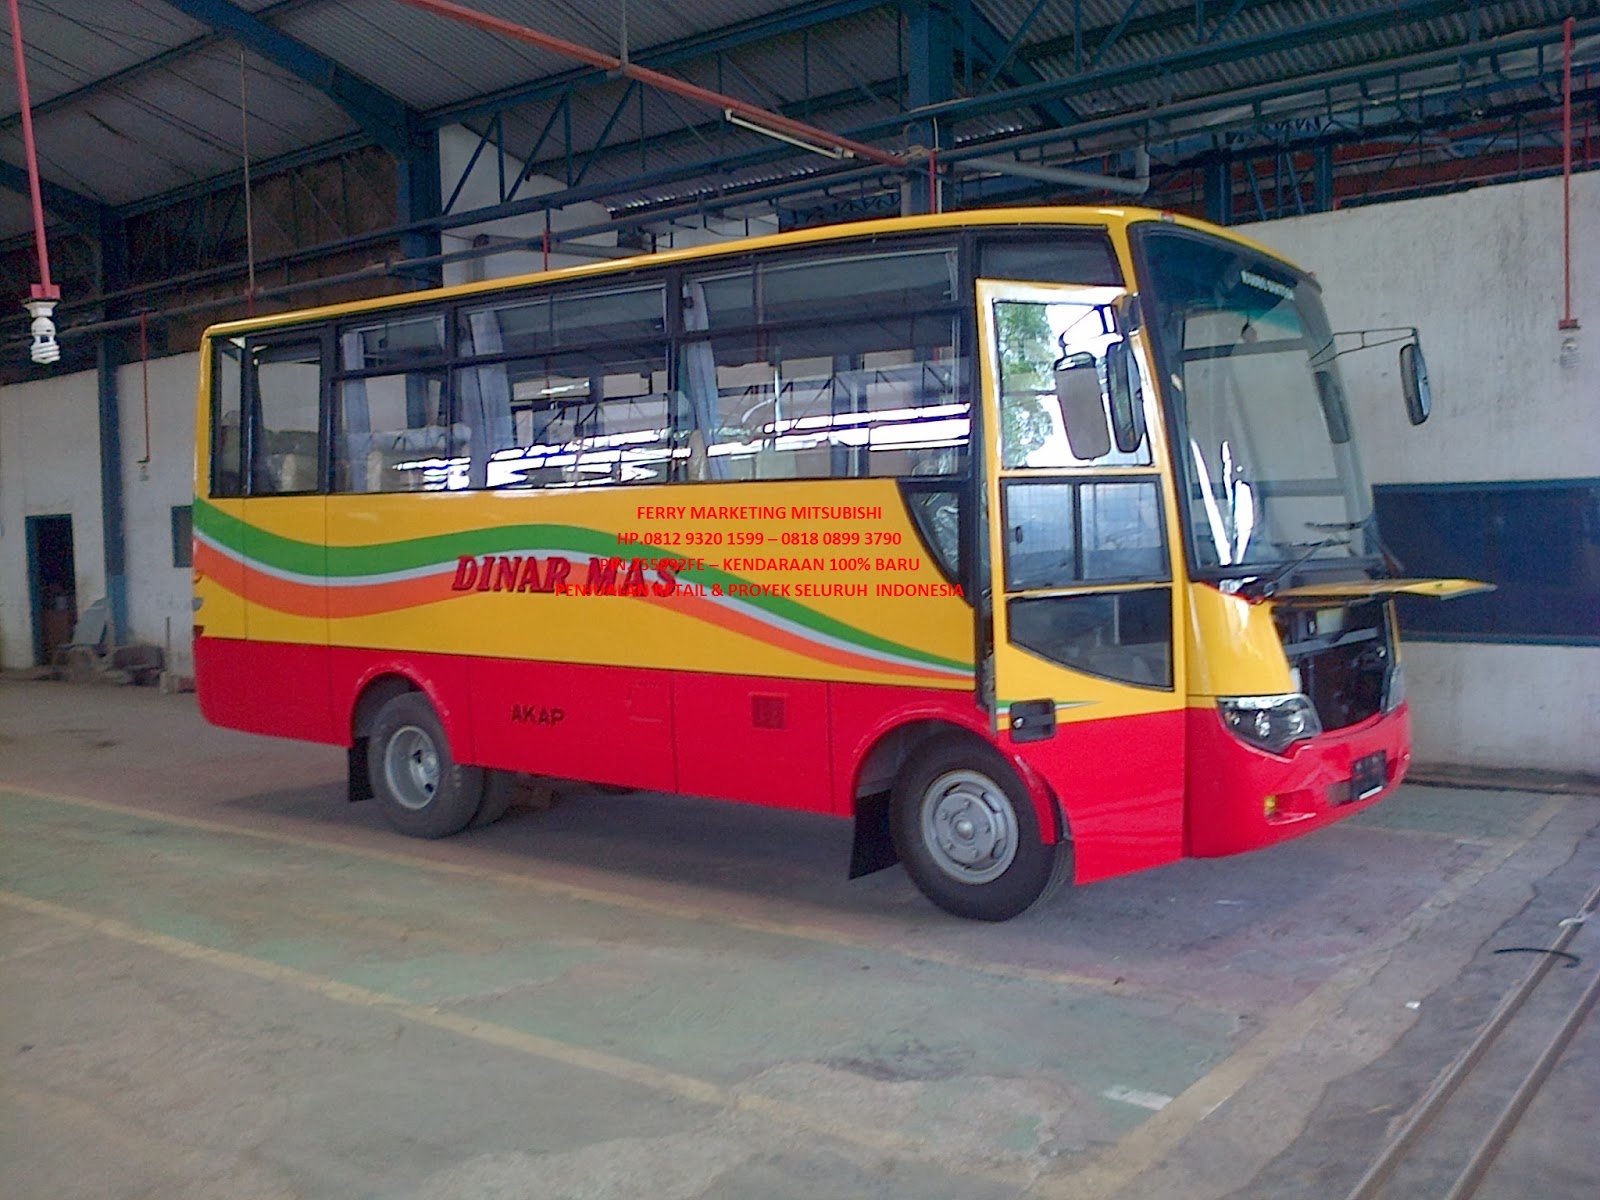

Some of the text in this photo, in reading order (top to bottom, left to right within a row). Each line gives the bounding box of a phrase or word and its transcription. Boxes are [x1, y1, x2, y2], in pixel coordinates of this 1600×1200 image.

[451, 555, 682, 598] DINAR MAS
[511, 704, 565, 727] AKAP
